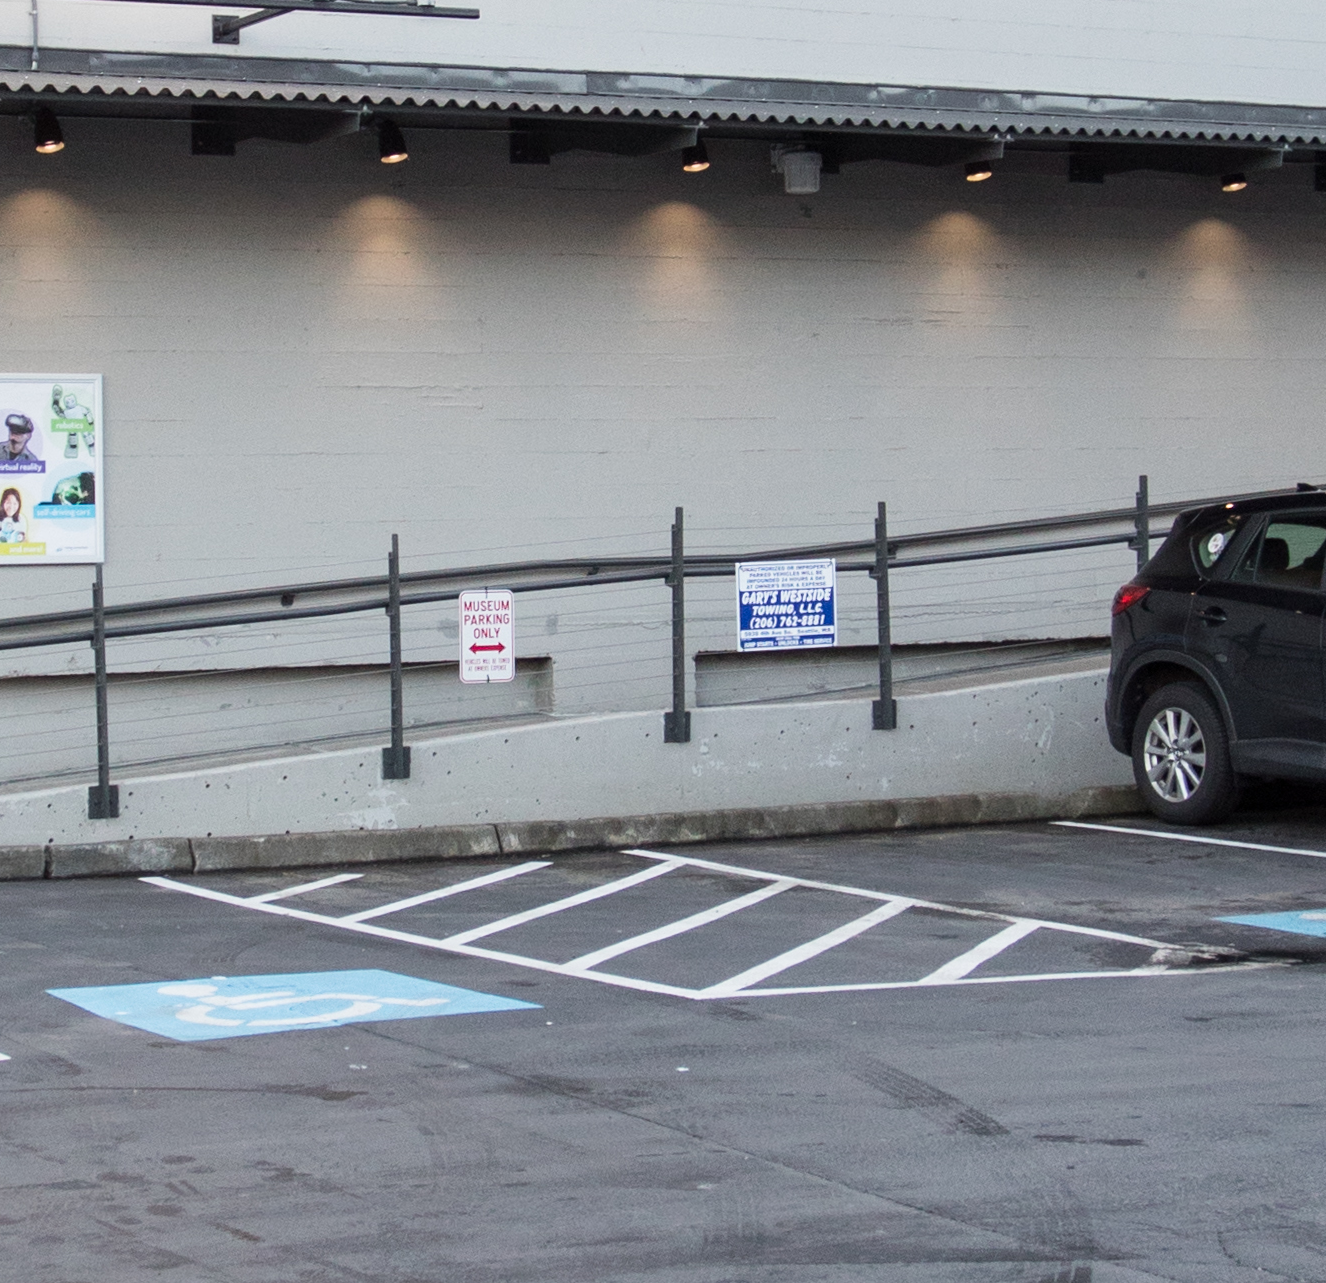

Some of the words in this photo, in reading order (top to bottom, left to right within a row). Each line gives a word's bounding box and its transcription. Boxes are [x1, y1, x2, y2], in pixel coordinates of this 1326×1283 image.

[55, 421, 84, 430] robotics
[19, 463, 43, 472] reality
[741, 590, 778, 605] GARY'S
[780, 588, 831, 603] WESTSIDE
[464, 600, 510, 612] MUSEUM
[752, 604, 797, 616] TOWING,
[464, 614, 510, 625] PARKING
[750, 616, 778, 629] (206)
[780, 614, 825, 627] 762-8881
[473, 627, 500, 639] ONLY
